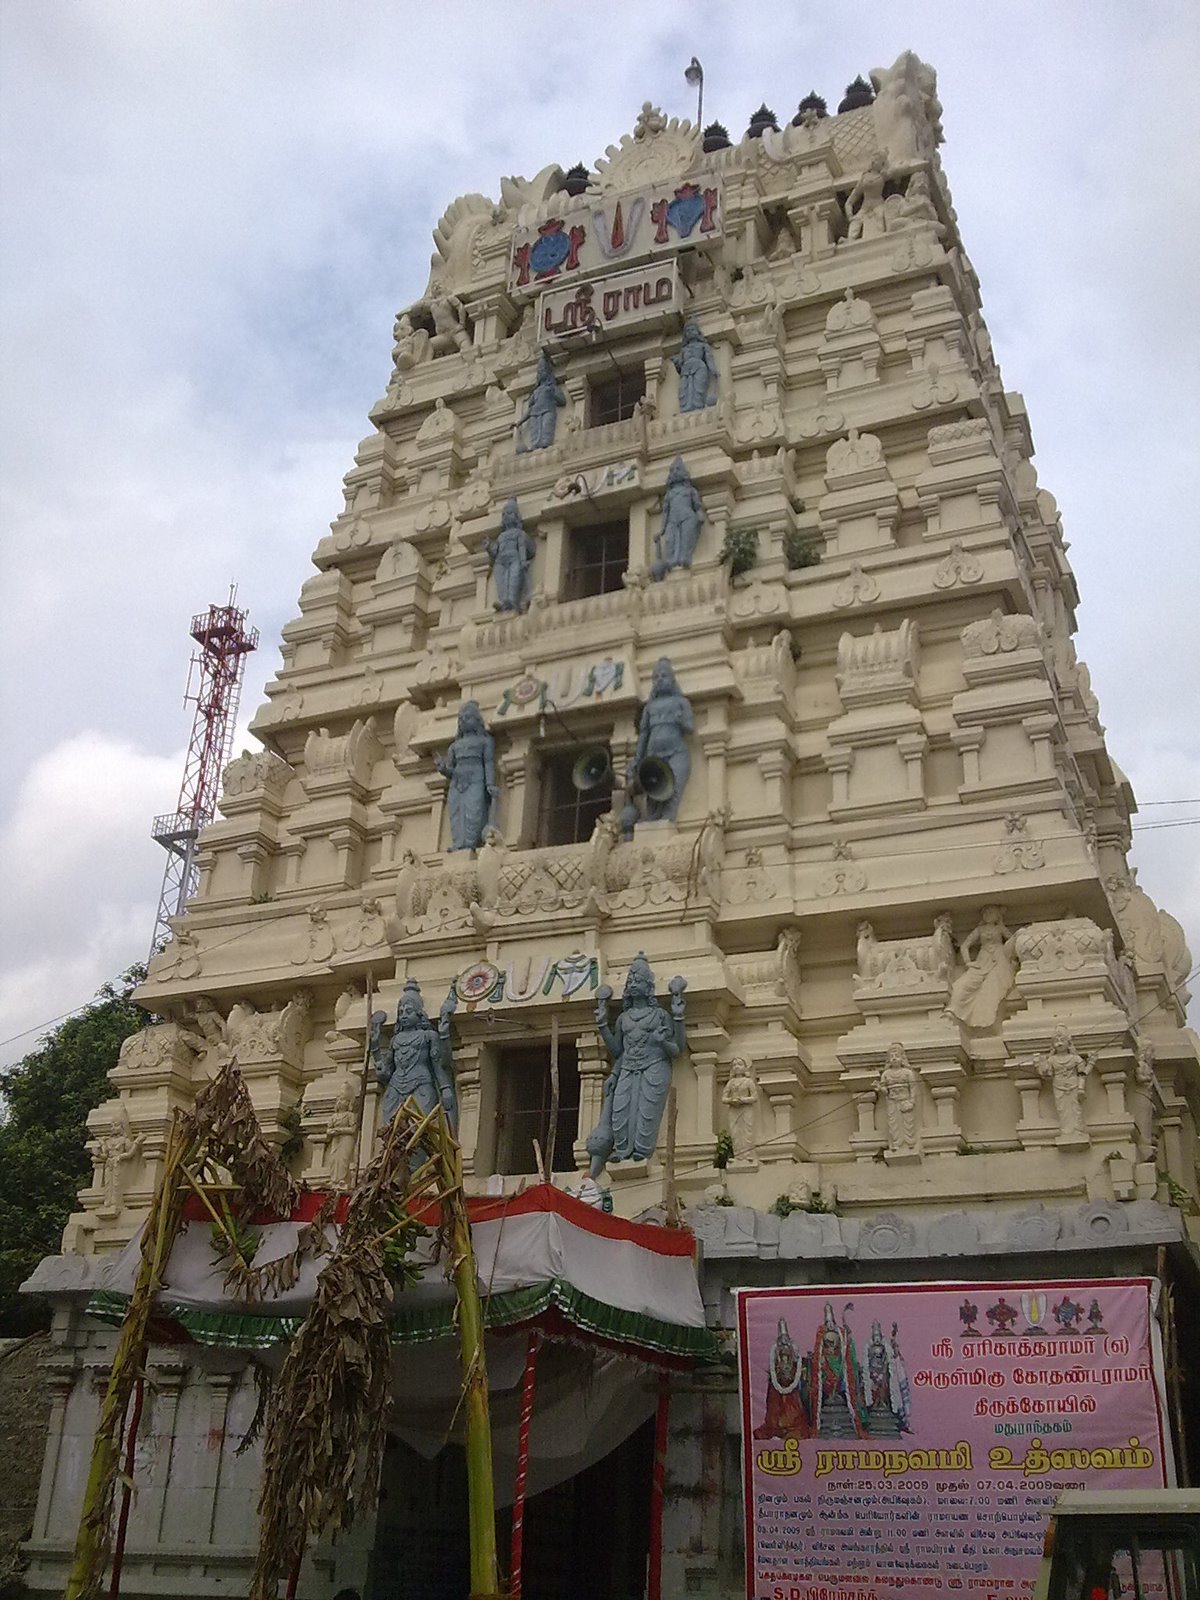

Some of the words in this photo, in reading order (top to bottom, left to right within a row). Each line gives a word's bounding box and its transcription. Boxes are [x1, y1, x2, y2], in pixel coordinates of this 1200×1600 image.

[603, 278, 673, 321] ராம
[931, 1338, 954, 1359] ஸ்ரீ
[962, 1336, 1096, 1360] ஏரிகாத்தராமர்
[1104, 1336, 1130, 1358] (எ)
[914, 1366, 1005, 1390] அருள்மிகு
[1012, 1364, 1151, 1387] கோதண்டராமர்
[974, 1394, 1097, 1418] திருக்கோயில்
[994, 1419, 1073, 1437] மதுராந்தகம்
[757, 1438, 801, 1476] ஸ்ரீ
[815, 1440, 973, 1478] ராமநவமி
[989, 1436, 1154, 1478] உத்ஸவம்
[936, 1478, 970, 1493] முதல்
